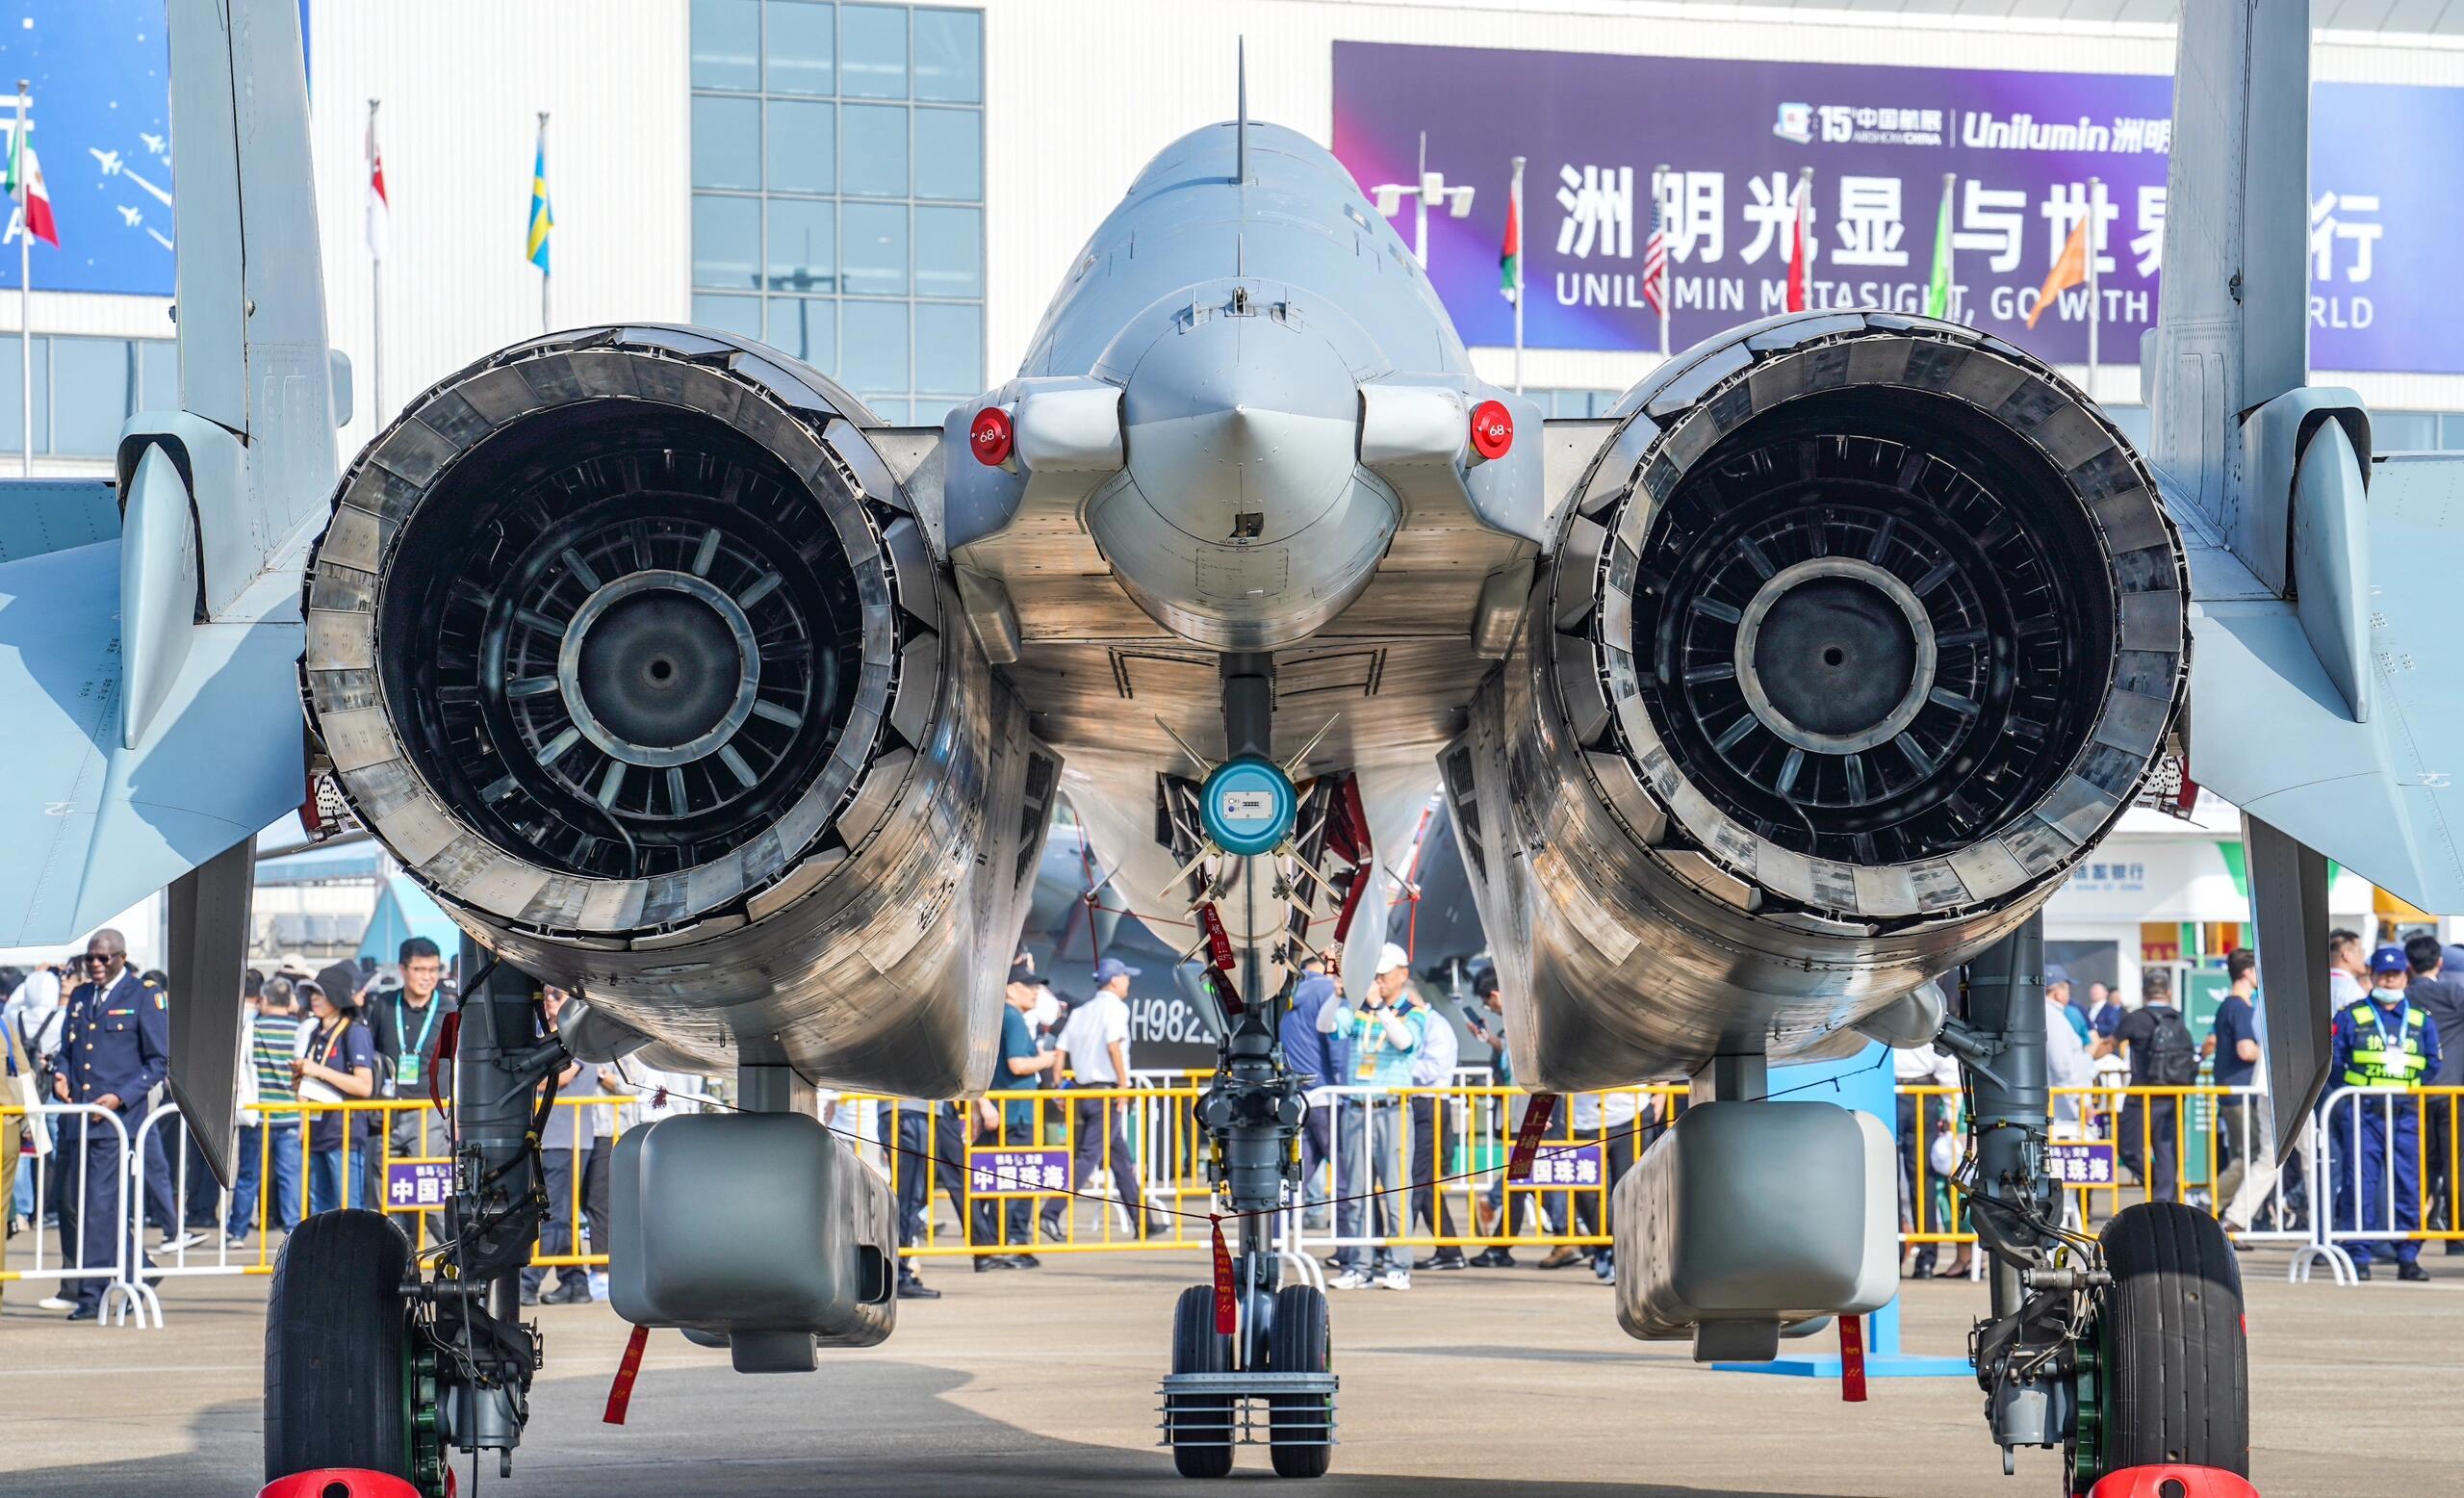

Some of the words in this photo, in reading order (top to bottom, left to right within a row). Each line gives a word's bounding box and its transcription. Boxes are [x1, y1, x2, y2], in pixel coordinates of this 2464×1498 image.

[1963, 112, 2110, 152] Unilumin
[1556, 272, 1744, 312] UNILMIN
[2057, 289, 2149, 323] WTH
[980, 429, 994, 443] 68
[1490, 425, 1504, 436] 68
[973, 1165, 1065, 1191] 中国珠海
[1518, 1159, 1598, 1184] 国珠海
[2049, 1157, 2110, 1181] 国珠海
